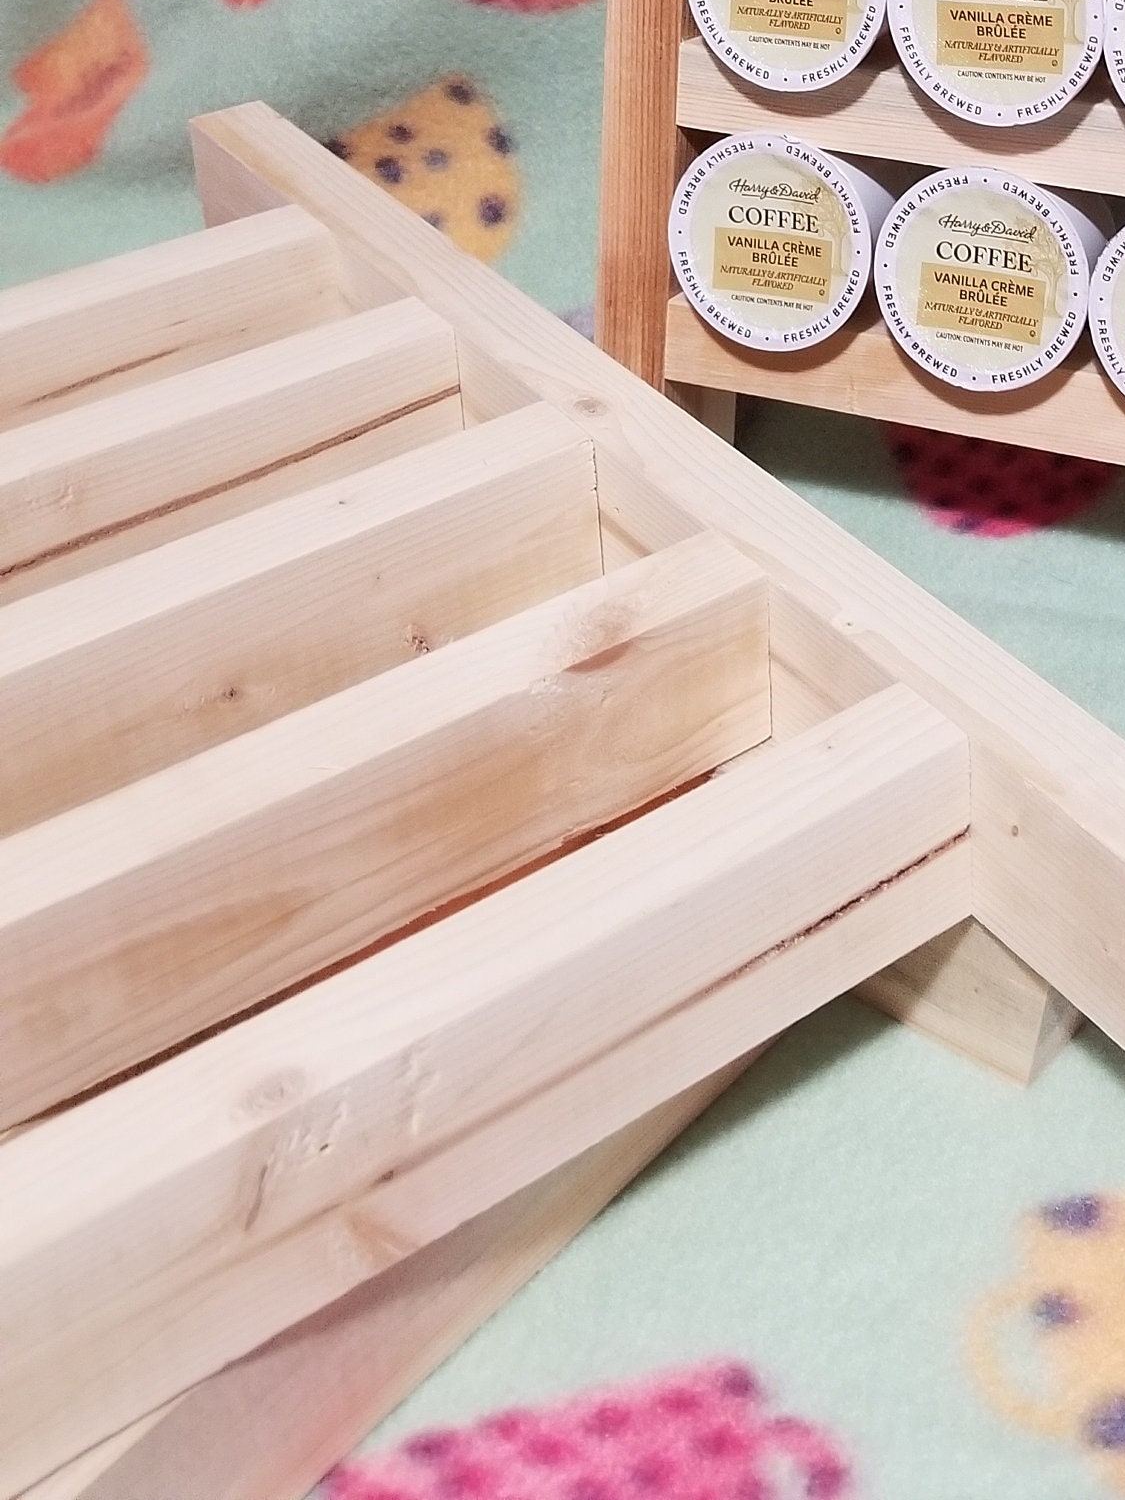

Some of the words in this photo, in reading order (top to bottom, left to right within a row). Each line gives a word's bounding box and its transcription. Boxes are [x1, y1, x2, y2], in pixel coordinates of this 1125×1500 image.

[738, 6, 784, 18] NATURALLY
[790, 11, 844, 25] ARTIFICIALLY
[769, 18, 811, 31] FLAVORED
[949, 9, 1005, 24] VANILLA
[1007, 10, 1053, 27] CRÈME
[976, 23, 1026, 40] BRÛLÉE
[802, 54, 849, 84] FRESHLY
[849, 5, 876, 55] BREWED
[943, 40, 994, 52] NATURALLY
[1000, 44, 1060, 57] ARTIFICIALLY
[725, 47, 770, 80] BREWED
[977, 52, 1023, 64] FLAVORED
[1017, 87, 1068, 118] FRESHLY
[1068, 36, 1098, 88] BREWED
[728, 205, 820, 234] COFFEE
[727, 235, 779, 252] VANILLA
[781, 240, 823, 258] CRÈME
[936, 241, 1033, 273] COFFEE
[752, 251, 799, 268] BRÛLÉE
[721, 264, 768, 278] NATURALLY
[774, 271, 829, 286] ARTIFICIALLY
[752, 277, 795, 291] FLAVORED
[934, 271, 988, 290] VANILLA
[990, 279, 1035, 298] CRÈME
[783, 316, 831, 343] FRESHLY
[831, 270, 860, 317] BREWED
[959, 289, 1008, 308] BRÛLÉE
[925, 300, 975, 316] NATURALLY
[981, 310, 1040, 327] ARTIFICIALLY
[958, 315, 1003, 330] FLAVORED
[883, 285, 911, 339] FRESHLY
[911, 341, 957, 377] BREWED
[1097, 319, 1124, 375] FRESHLY
